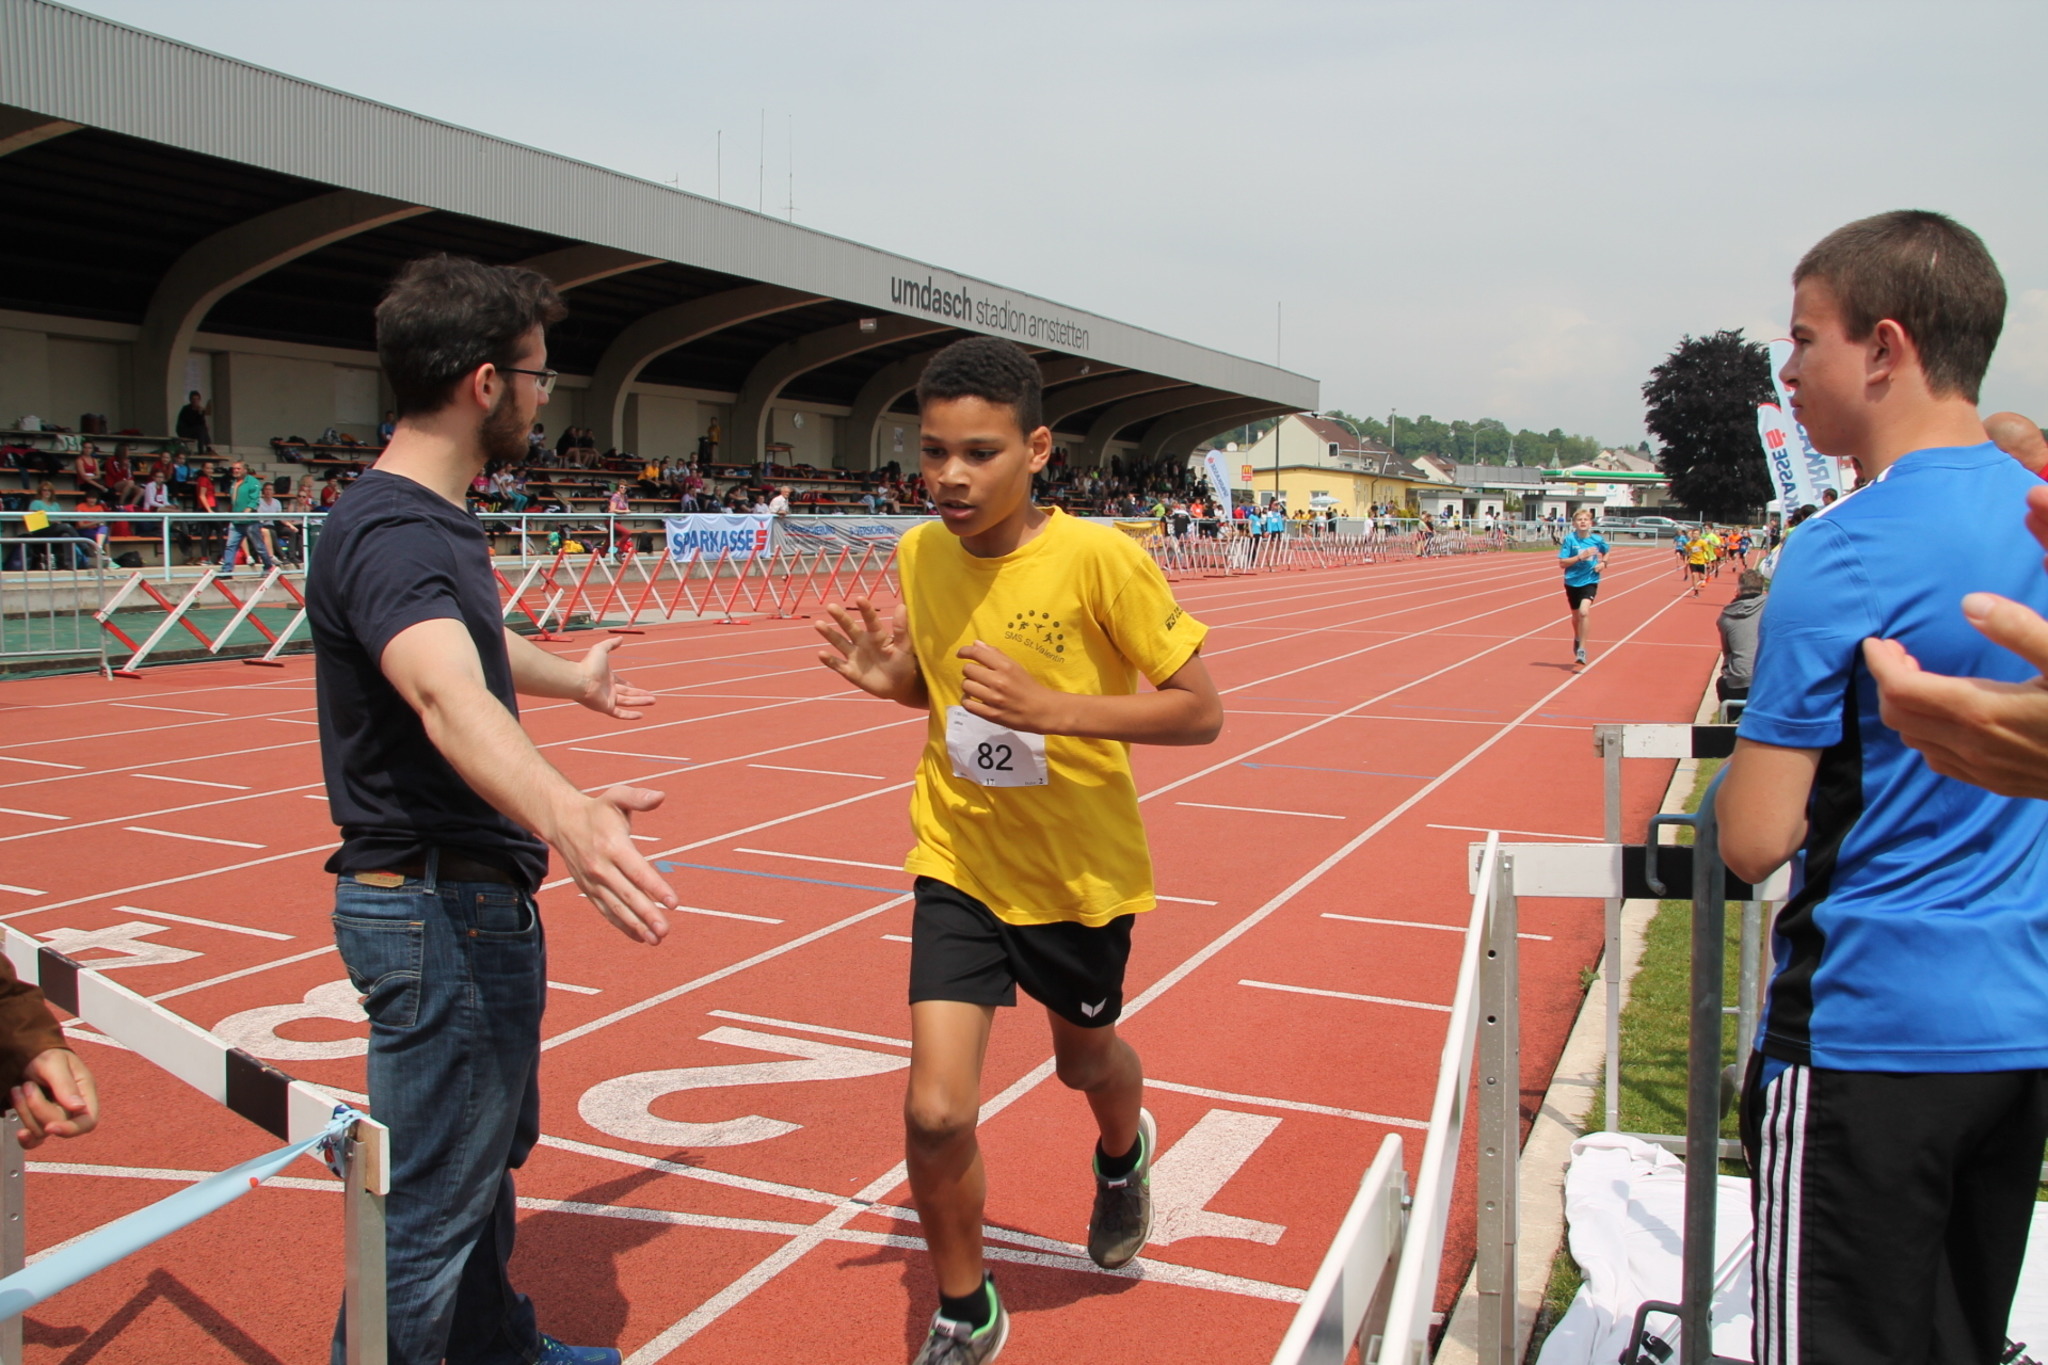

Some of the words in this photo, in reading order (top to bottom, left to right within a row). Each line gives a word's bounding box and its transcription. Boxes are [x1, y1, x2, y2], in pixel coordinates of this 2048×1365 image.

[891, 276, 972, 321] umdasch
[976, 298, 1026, 335] stadion
[1028, 314, 1089, 350] amstetten
[673, 530, 753, 555] SPARKASSE
[1004, 630, 1023, 643] SMS
[1035, 643, 1065, 663] Valentin
[977, 742, 1014, 771] 82
[578, 1026, 913, 1147] 2
